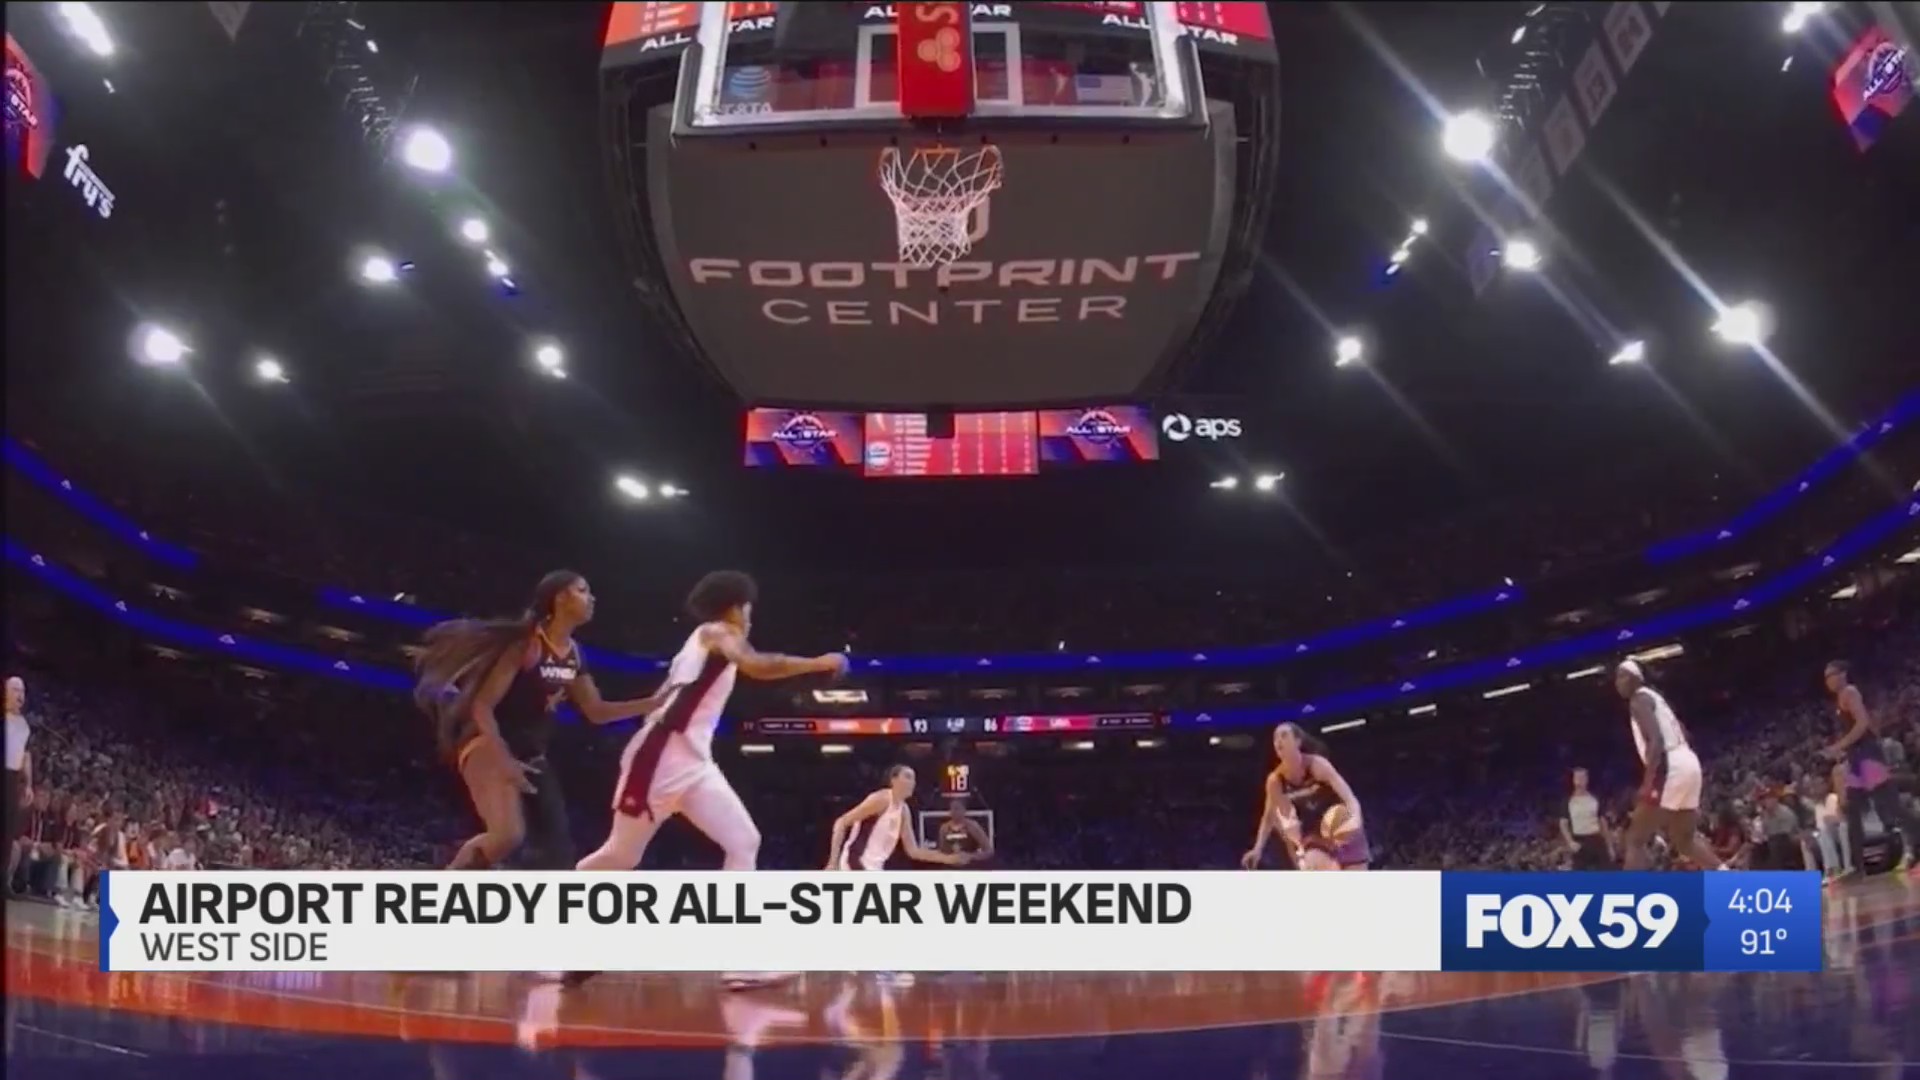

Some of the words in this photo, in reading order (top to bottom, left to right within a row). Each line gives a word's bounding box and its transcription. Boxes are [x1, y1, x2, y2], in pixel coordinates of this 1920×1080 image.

[864, 5, 899, 19] AL
[640, 33, 691, 52] ALL
[721, 15, 775, 34] TAR
[689, 252, 1201, 289] FOOTPRINT
[762, 296, 1127, 325] CENTER
[1194, 418, 1243, 441] aps
[913, 719, 928, 733] 93
[983, 718, 998, 732] 86
